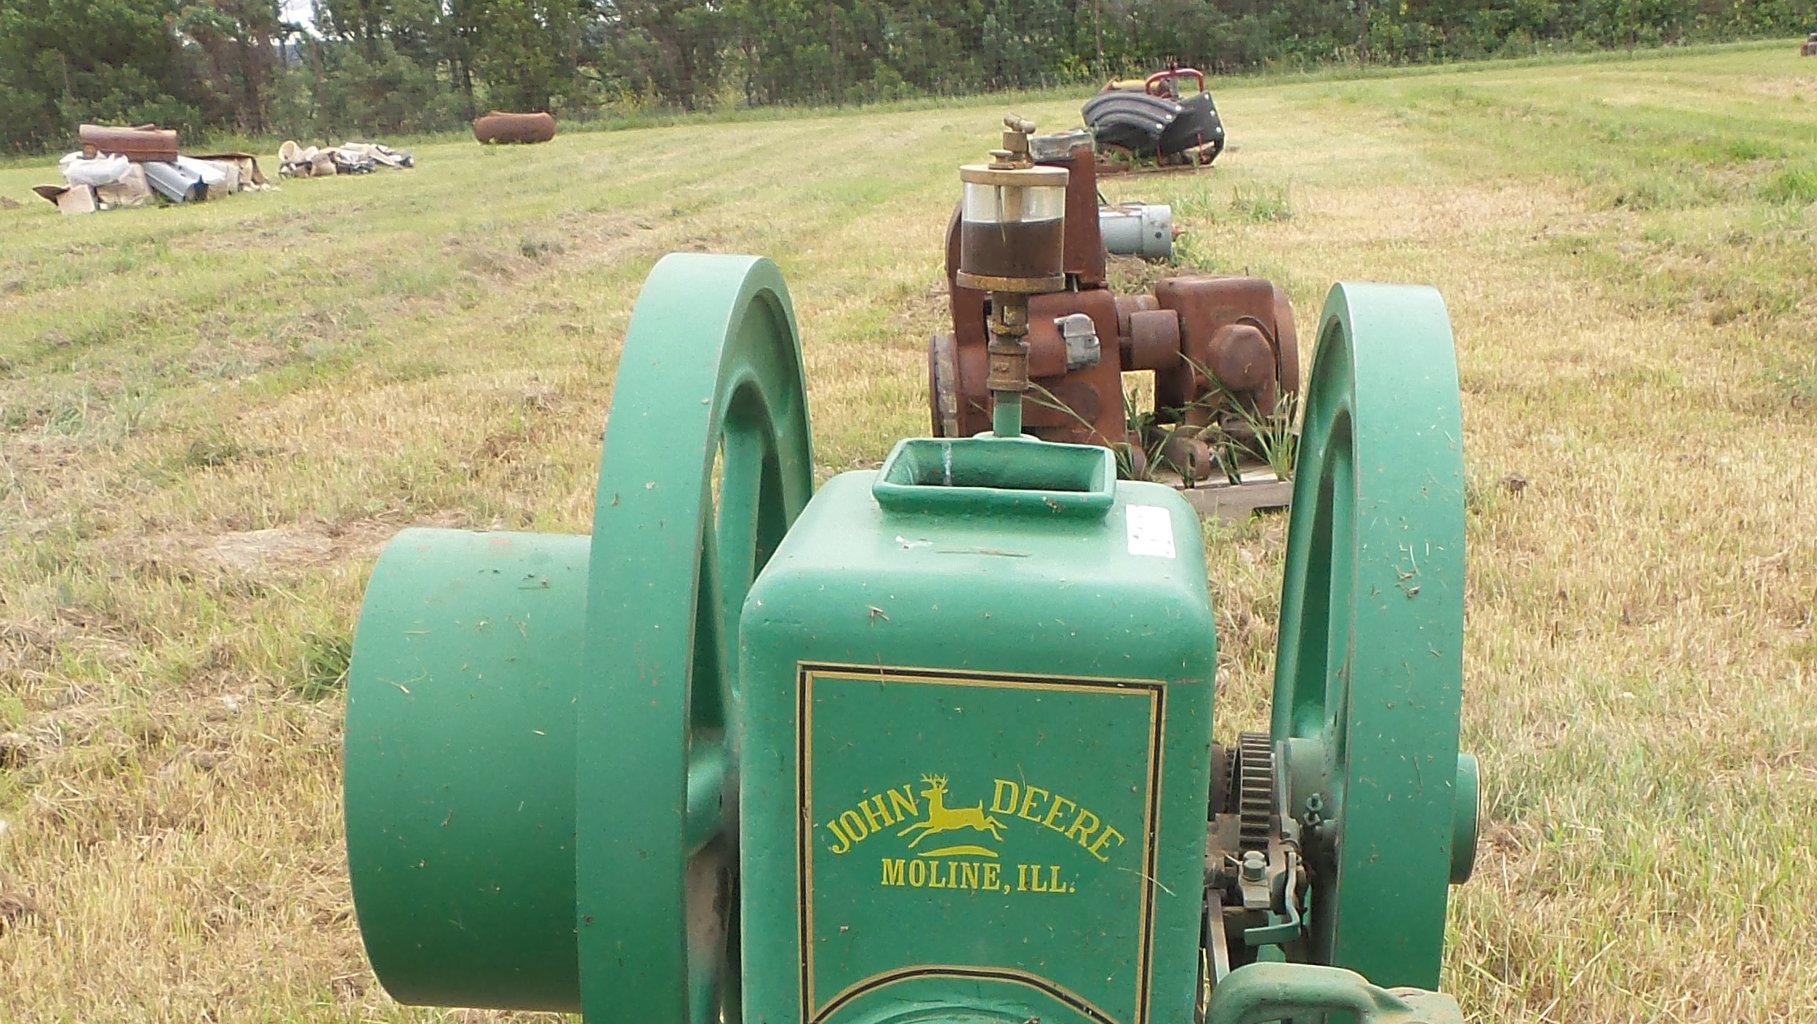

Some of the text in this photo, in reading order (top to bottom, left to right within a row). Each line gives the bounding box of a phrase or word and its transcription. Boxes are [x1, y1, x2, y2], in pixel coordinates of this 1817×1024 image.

[827, 778, 1125, 862] JOHN DEERE
[881, 857, 1076, 895] MOLINE, ILL.
